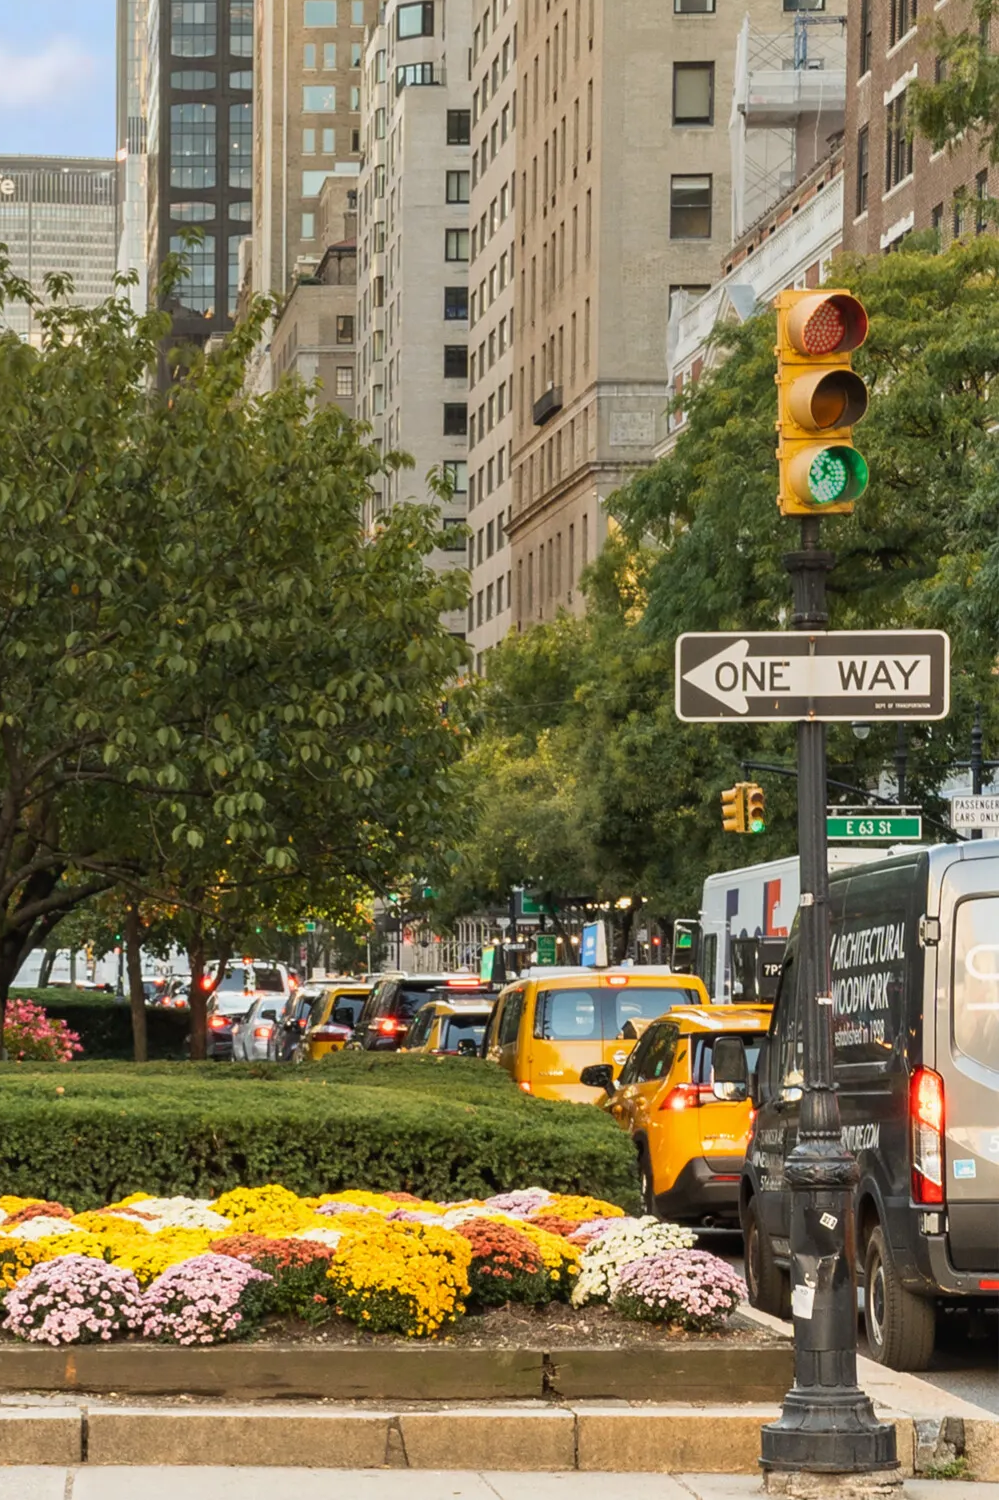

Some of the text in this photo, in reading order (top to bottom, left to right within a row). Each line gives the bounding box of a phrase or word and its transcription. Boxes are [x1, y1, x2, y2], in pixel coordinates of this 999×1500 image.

[715, 660, 921, 692] ONE WAY
[955, 800, 999, 810] PASSENGER
[955, 812, 999, 822] CARS ONLY
[846, 821, 892, 835] E 63 St
[833, 922, 905, 970] ARCHITECTURAL
[832, 972, 892, 1017] WOODWORK
[834, 1021, 863, 1047] established
